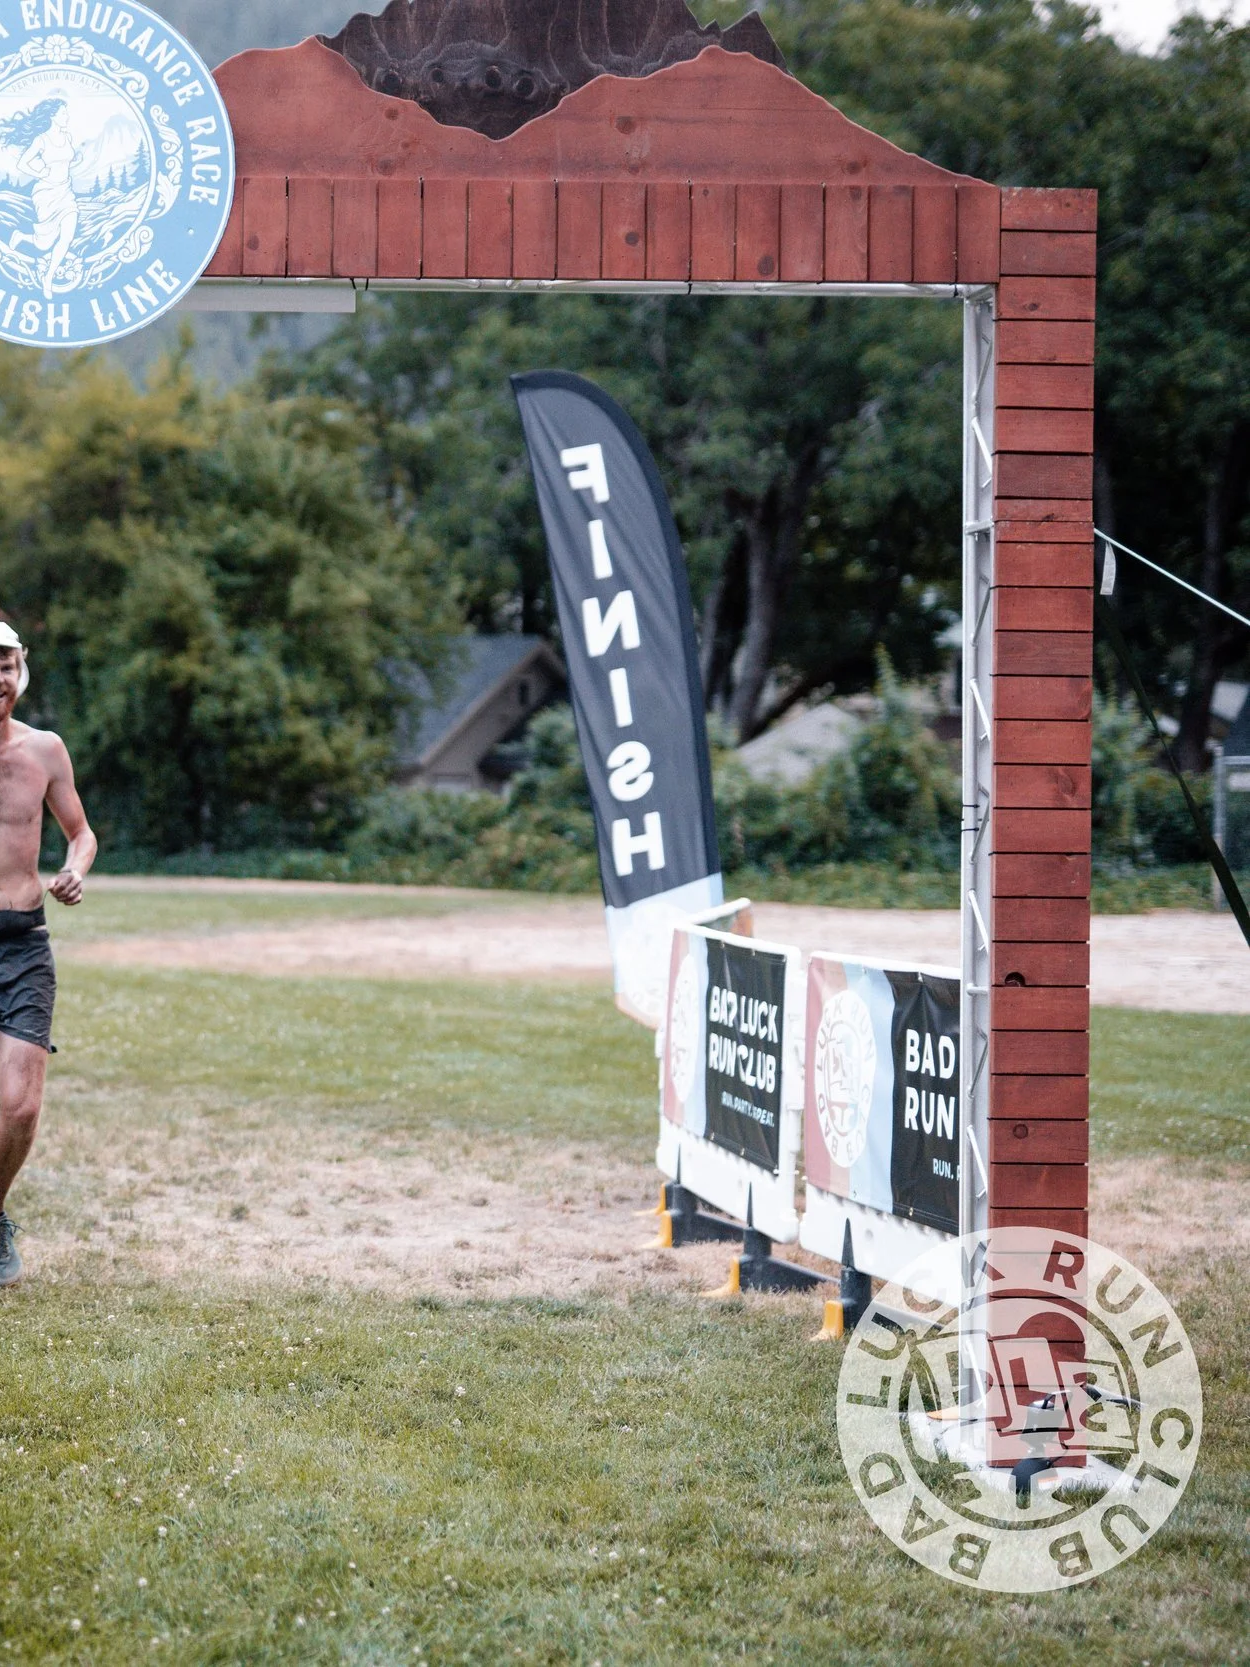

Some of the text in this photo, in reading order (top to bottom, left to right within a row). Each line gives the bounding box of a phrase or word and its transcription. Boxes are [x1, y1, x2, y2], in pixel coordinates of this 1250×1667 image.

[20, 0, 205, 107] ENDURANCE
[186, 115, 221, 206] RACE
[91, 258, 181, 332] LINE
[740, 995, 778, 1043] LUCK
[709, 1032, 776, 1093] RUN CLUB
[905, 1029, 955, 1079] BAD
[904, 1087, 955, 1140] RUN
[933, 1158, 954, 1179] RUN.
